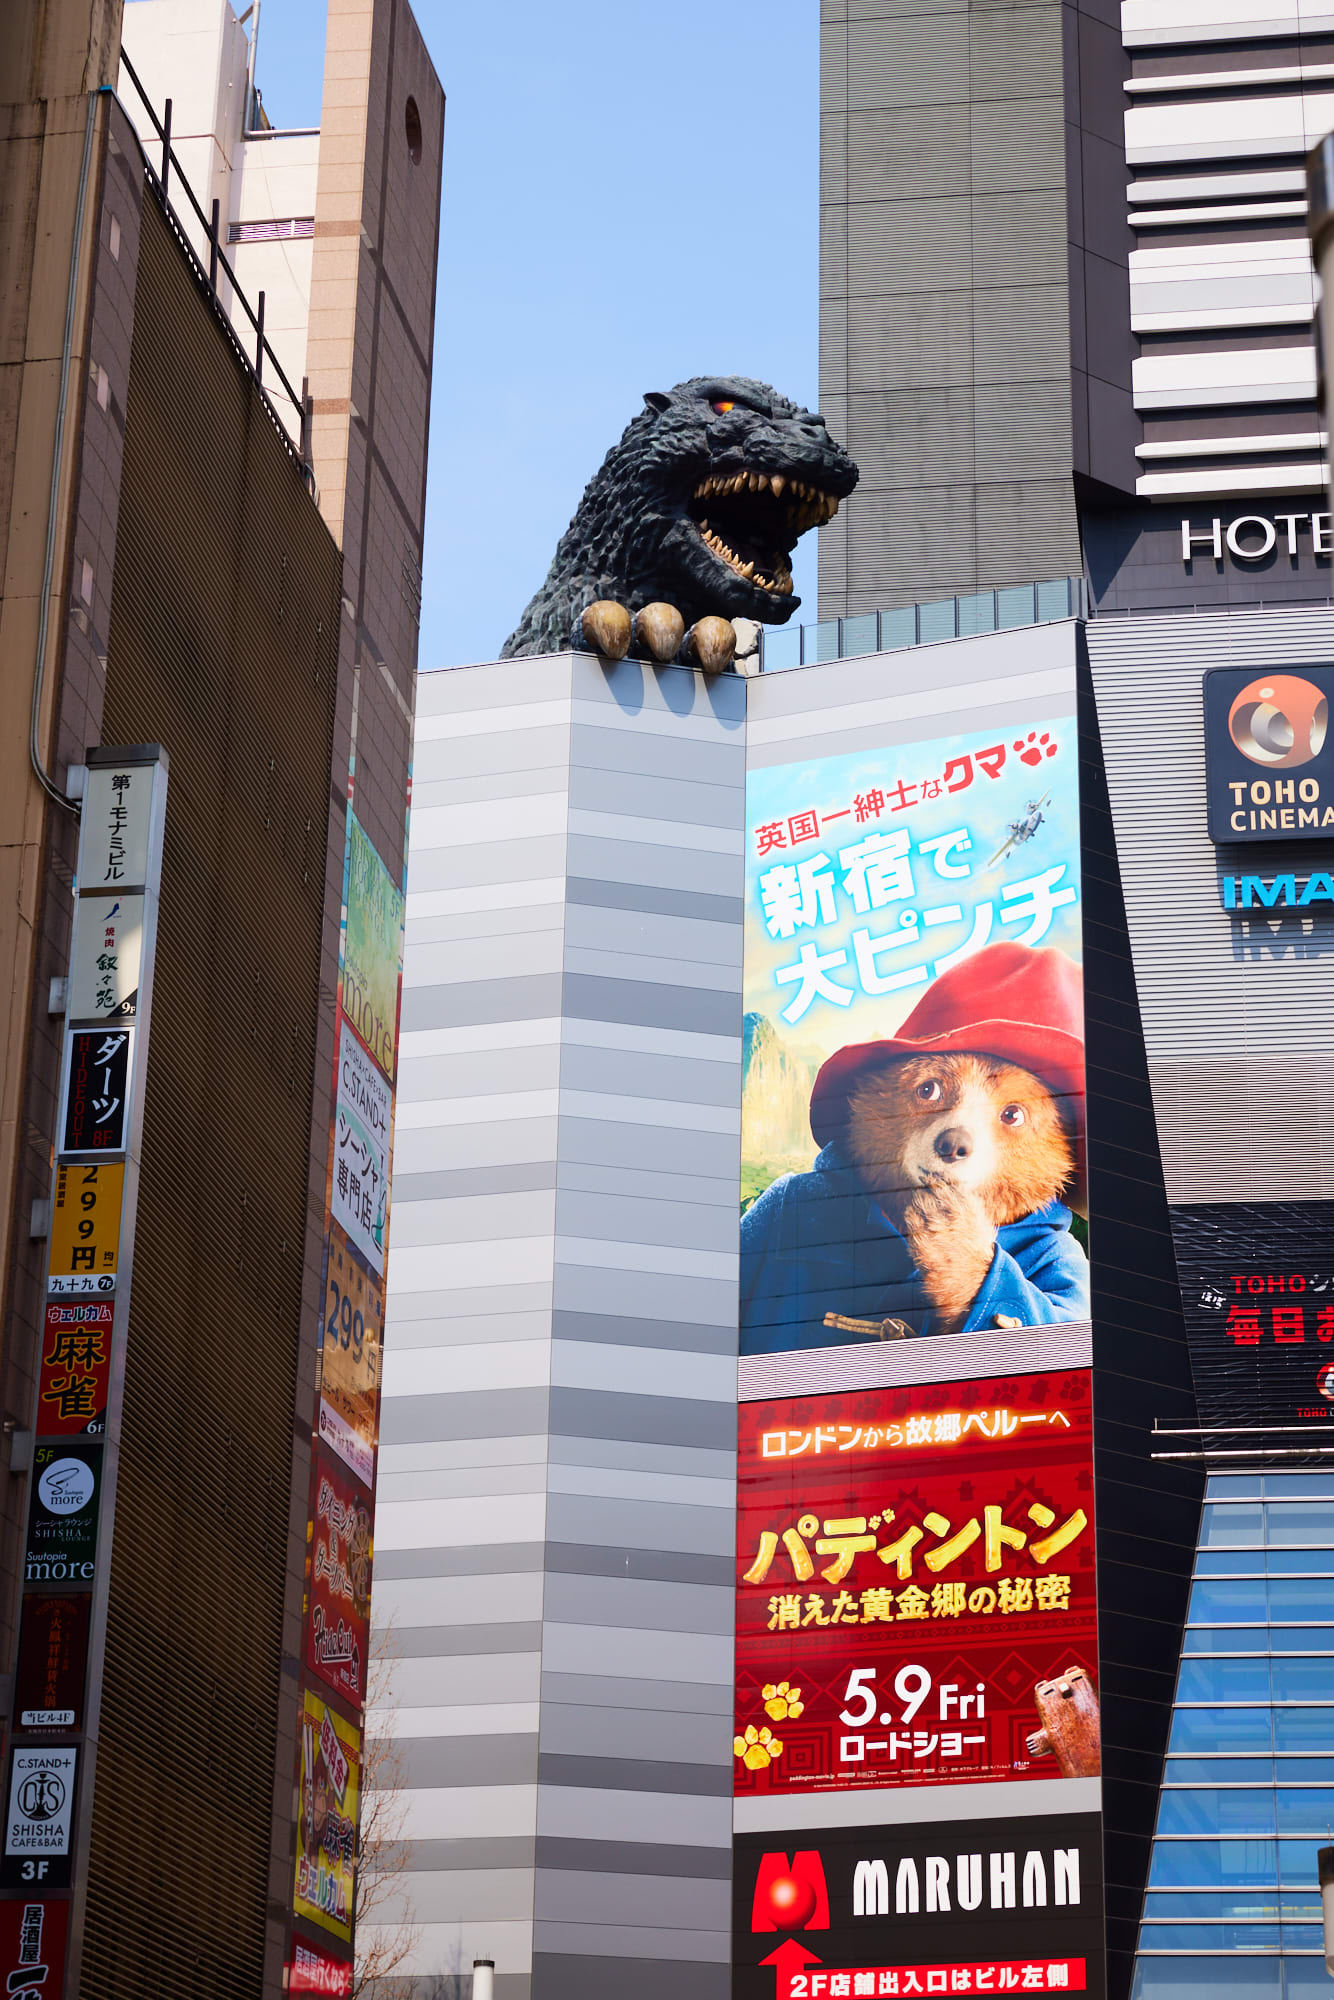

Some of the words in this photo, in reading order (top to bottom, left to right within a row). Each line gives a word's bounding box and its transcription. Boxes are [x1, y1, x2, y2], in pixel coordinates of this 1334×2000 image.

[1181, 513, 1333, 560] HOTE
[755, 744, 1006, 857] 英国一紳士なクマ
[1228, 778, 1320, 806] TOHO
[104, 774, 132, 881] 第1モナミビル
[1230, 806, 1334, 832] CINEMA
[759, 828, 973, 939] 新宿で
[1223, 872, 1334, 909] IMA
[104, 927, 115, 948] 焼肉
[775, 864, 1077, 1025] 大ピンチ
[95, 953, 118, 1009] 叙々苑
[121, 1001, 136, 1015] 9F
[344, 970, 393, 1074] more
[73, 1036, 90, 1148] HIDEOUT
[91, 1034, 127, 1124] ダーツ
[92, 1130, 114, 1147] 8F
[339, 1112, 379, 1193] シーシャ
[336, 1158, 373, 1235] 専門店
[70, 1166, 98, 1270] 299円
[102, 1251, 114, 1267] 均一
[51, 1278, 94, 1291] 九十九
[1230, 1274, 1334, 1294] TOHOシ
[48, 1306, 112, 1323] ウェルカム
[42, 1327, 105, 1419] 麻雀
[86, 1420, 105, 1434] 6F
[1296, 1407, 1327, 1418] TOHO
[762, 1409, 1071, 1458] ロンドンから故郷ペルーへ
[35, 1449, 54, 1463] 5F
[51, 1495, 83, 1505] more
[35, 1528, 82, 1538] SHISHA
[742, 1502, 1088, 1585] パディントン
[25, 1561, 95, 1580] more
[27, 1551, 67, 1562] Suutopia
[767, 1574, 1071, 1631] 消えた黄金郷の秘密
[838, 1664, 932, 1727] 5.9
[939, 1683, 986, 1721] Fri
[17, 1758, 72, 1769] C.STAND+
[840, 1731, 986, 1763] ロードショー
[11, 1837, 63, 1848] CAFE&BAR
[12, 1824, 64, 1837] SHISHA
[21, 1860, 49, 1881] 3F
[853, 1848, 1081, 1916] MARUHAN
[298, 1855, 348, 1926] ウェルカム
[19, 1904, 44, 1965] 居酒屋
[790, 1963, 1069, 1999] 2F店舗出入口はビル左側
